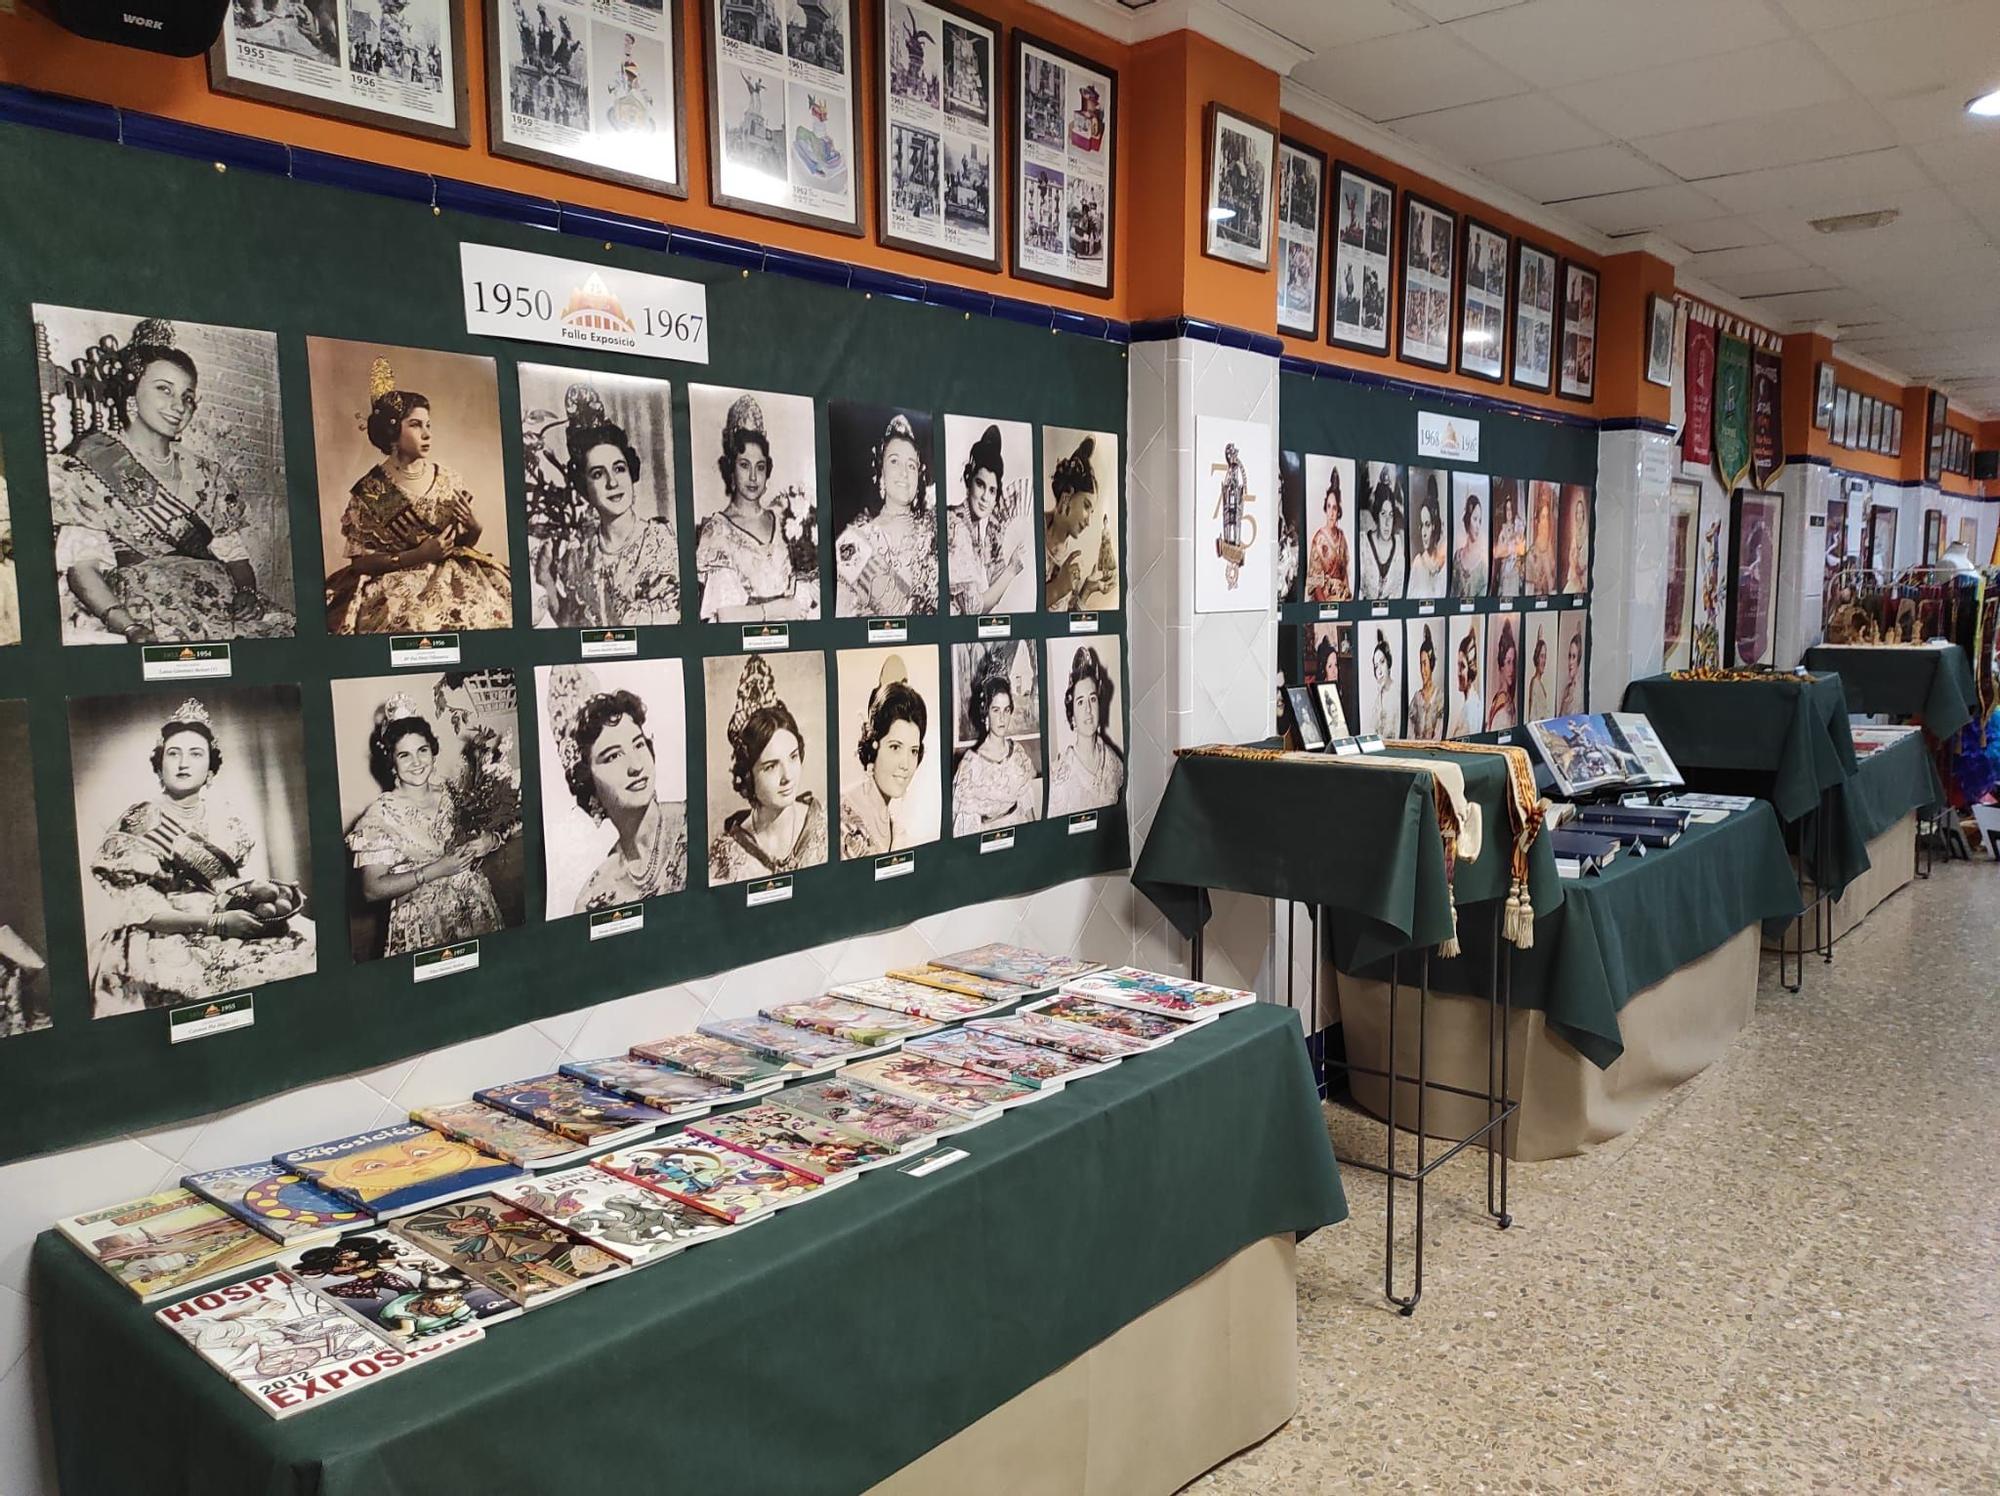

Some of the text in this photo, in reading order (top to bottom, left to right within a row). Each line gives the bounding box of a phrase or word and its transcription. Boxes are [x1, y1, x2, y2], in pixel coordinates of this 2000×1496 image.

[123, 13, 164, 31] WORK
[237, 44, 265, 59] 1955
[351, 74, 376, 88] 1956
[512, 114, 533, 127] 1959
[472, 281, 704, 343] 1950 1967
[561, 328, 587, 341] Falla
[161, 1271, 295, 1323] HOSPI
[258, 1371, 315, 1396] 2012
